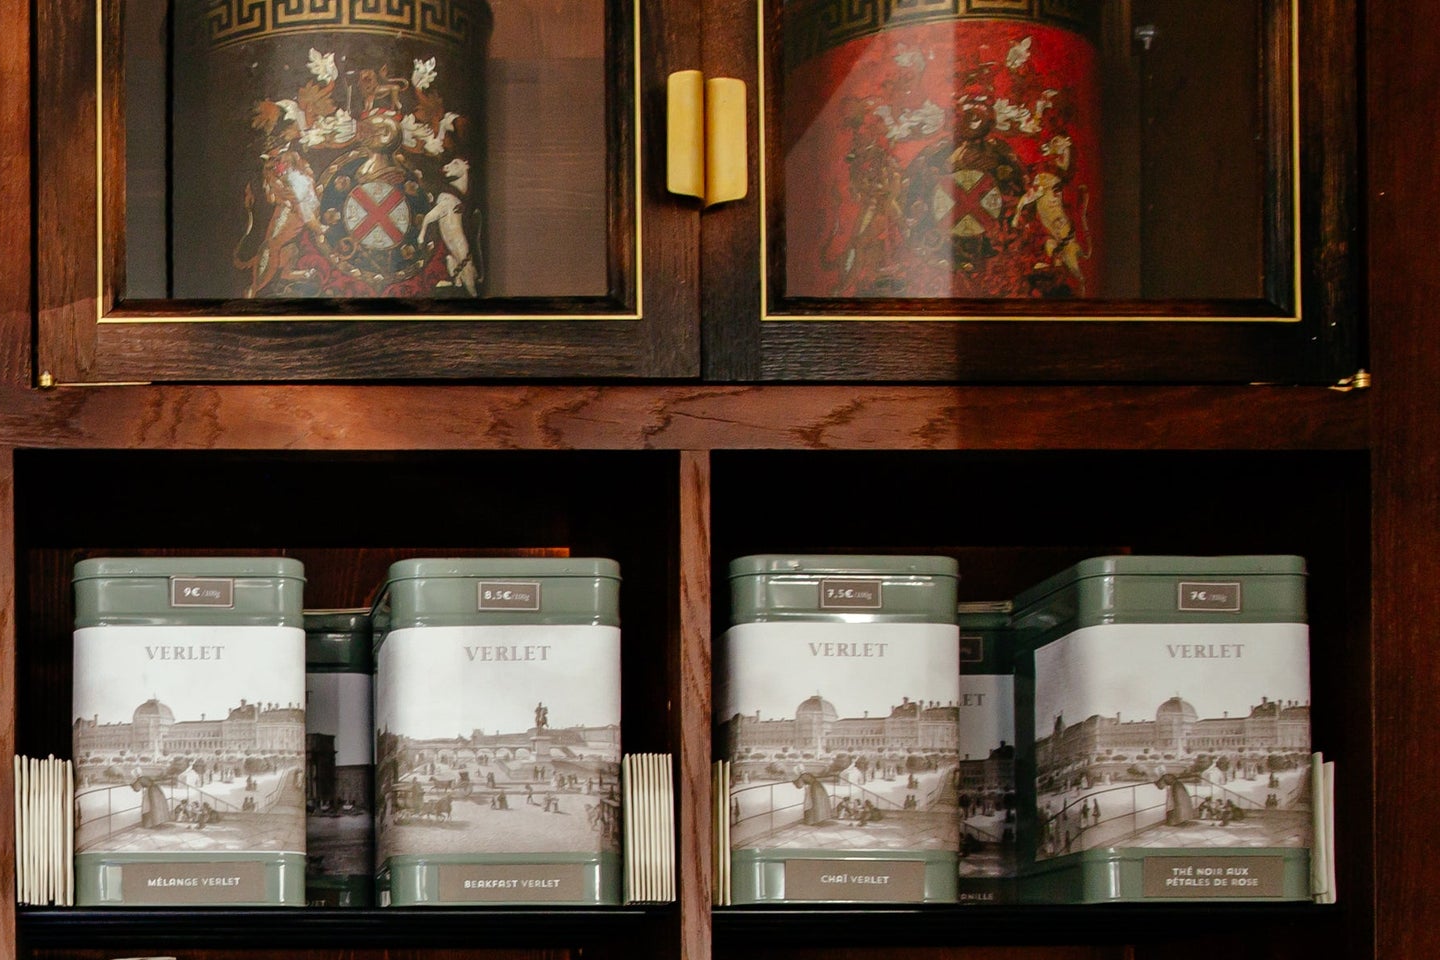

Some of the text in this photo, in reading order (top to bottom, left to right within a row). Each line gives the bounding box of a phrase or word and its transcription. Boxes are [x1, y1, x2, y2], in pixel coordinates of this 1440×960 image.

[184, 587, 200, 597] 9€
[1190, 591, 1206, 601] 7€
[144, 646, 225, 660] VERLET
[463, 646, 551, 661] VERLET
[807, 643, 888, 657] VERLET
[1165, 644, 1245, 658] VERLET
[1172, 866, 1192, 875] THÉ
[148, 877, 240, 886] MÉLANGE VERLET
[465, 880, 518, 888] BEAKFAST
[851, 876, 889, 884] VERLET
[1166, 877, 1258, 886] PÉTALES DE ROSE
